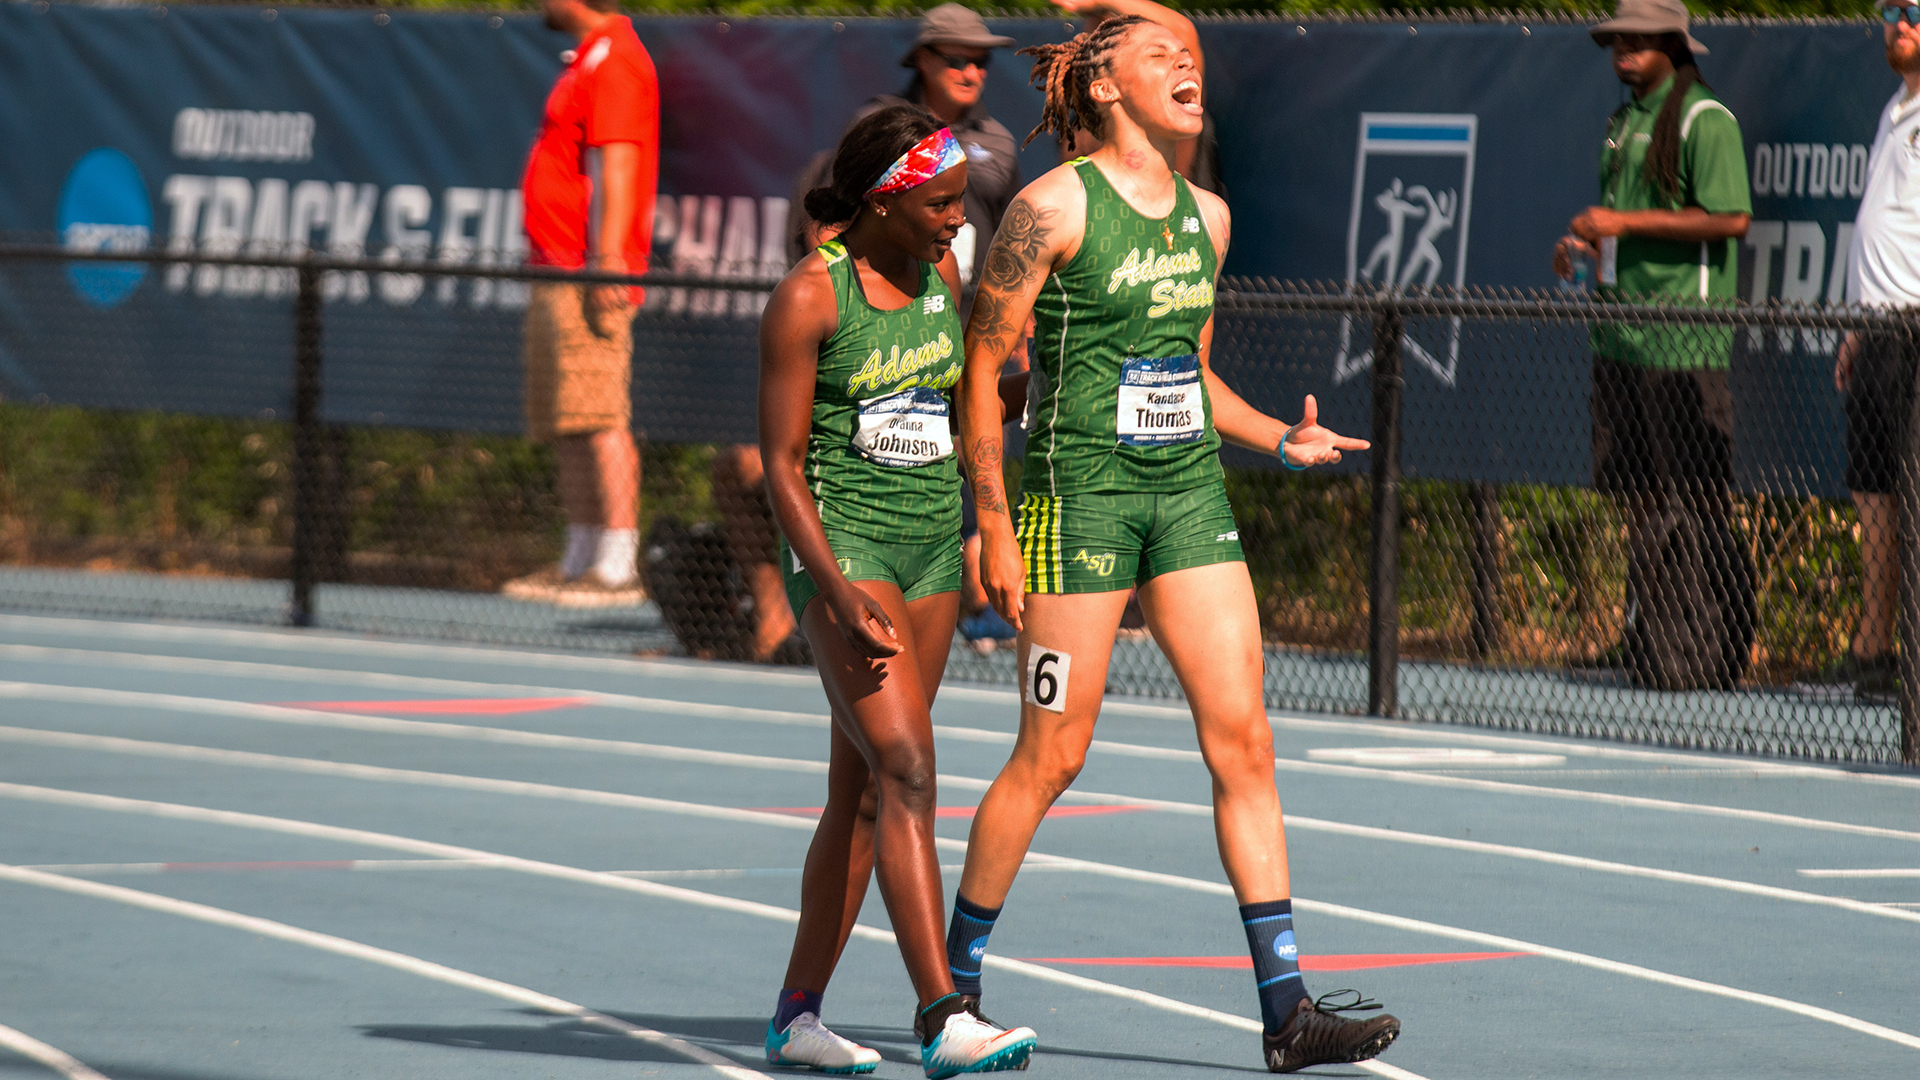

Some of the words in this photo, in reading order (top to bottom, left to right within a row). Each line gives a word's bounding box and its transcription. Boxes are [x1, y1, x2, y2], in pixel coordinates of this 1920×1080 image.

[1754, 142, 1871, 198] OUTDOO
[1107, 247, 1202, 294] Adams
[1147, 277, 1214, 318] State
[846, 331, 953, 397] Adams
[1136, 408, 1192, 428] Thomas
[1147, 392, 1186, 405] Kandace
[867, 432, 940, 457] Johnson
[1069, 548, 1116, 577] ASU
[1034, 652, 1059, 706] 6
